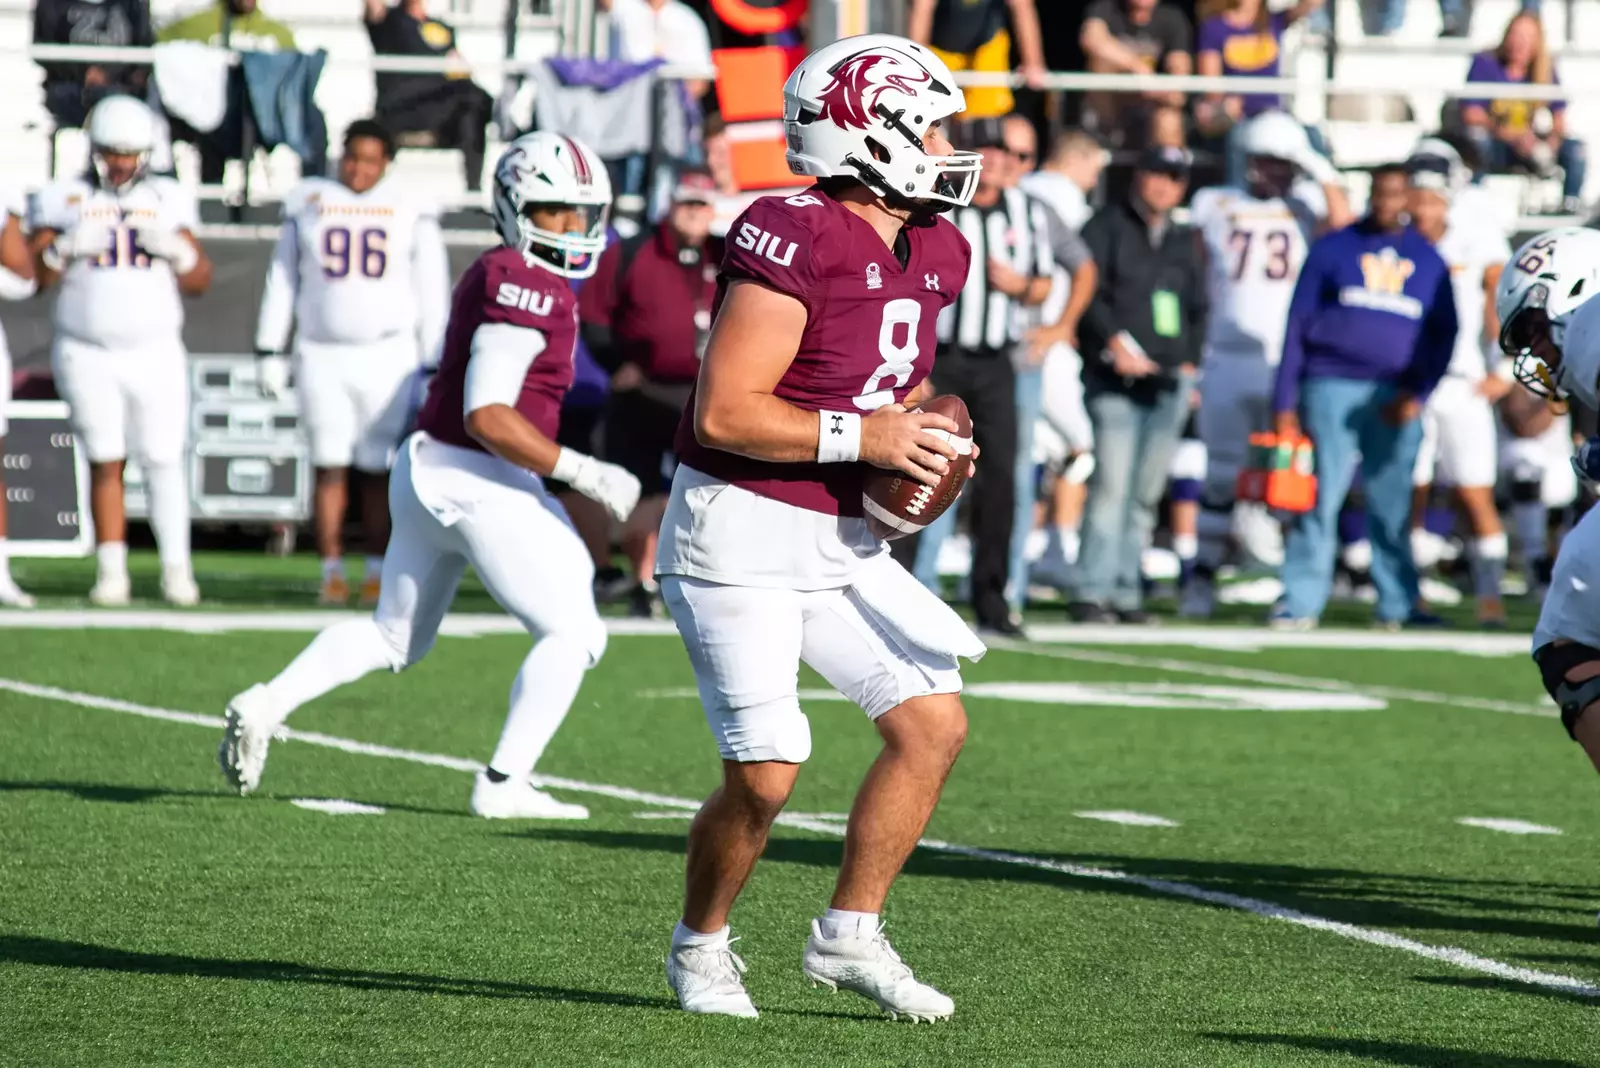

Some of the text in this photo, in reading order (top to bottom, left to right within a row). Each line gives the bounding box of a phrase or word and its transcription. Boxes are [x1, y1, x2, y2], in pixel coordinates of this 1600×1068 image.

[321, 226, 389, 280] 96
[735, 222, 799, 267] SIU
[1228, 228, 1290, 281] 73
[1515, 239, 1557, 276] 65
[496, 282, 554, 317] SIU
[852, 298, 922, 410] 8
